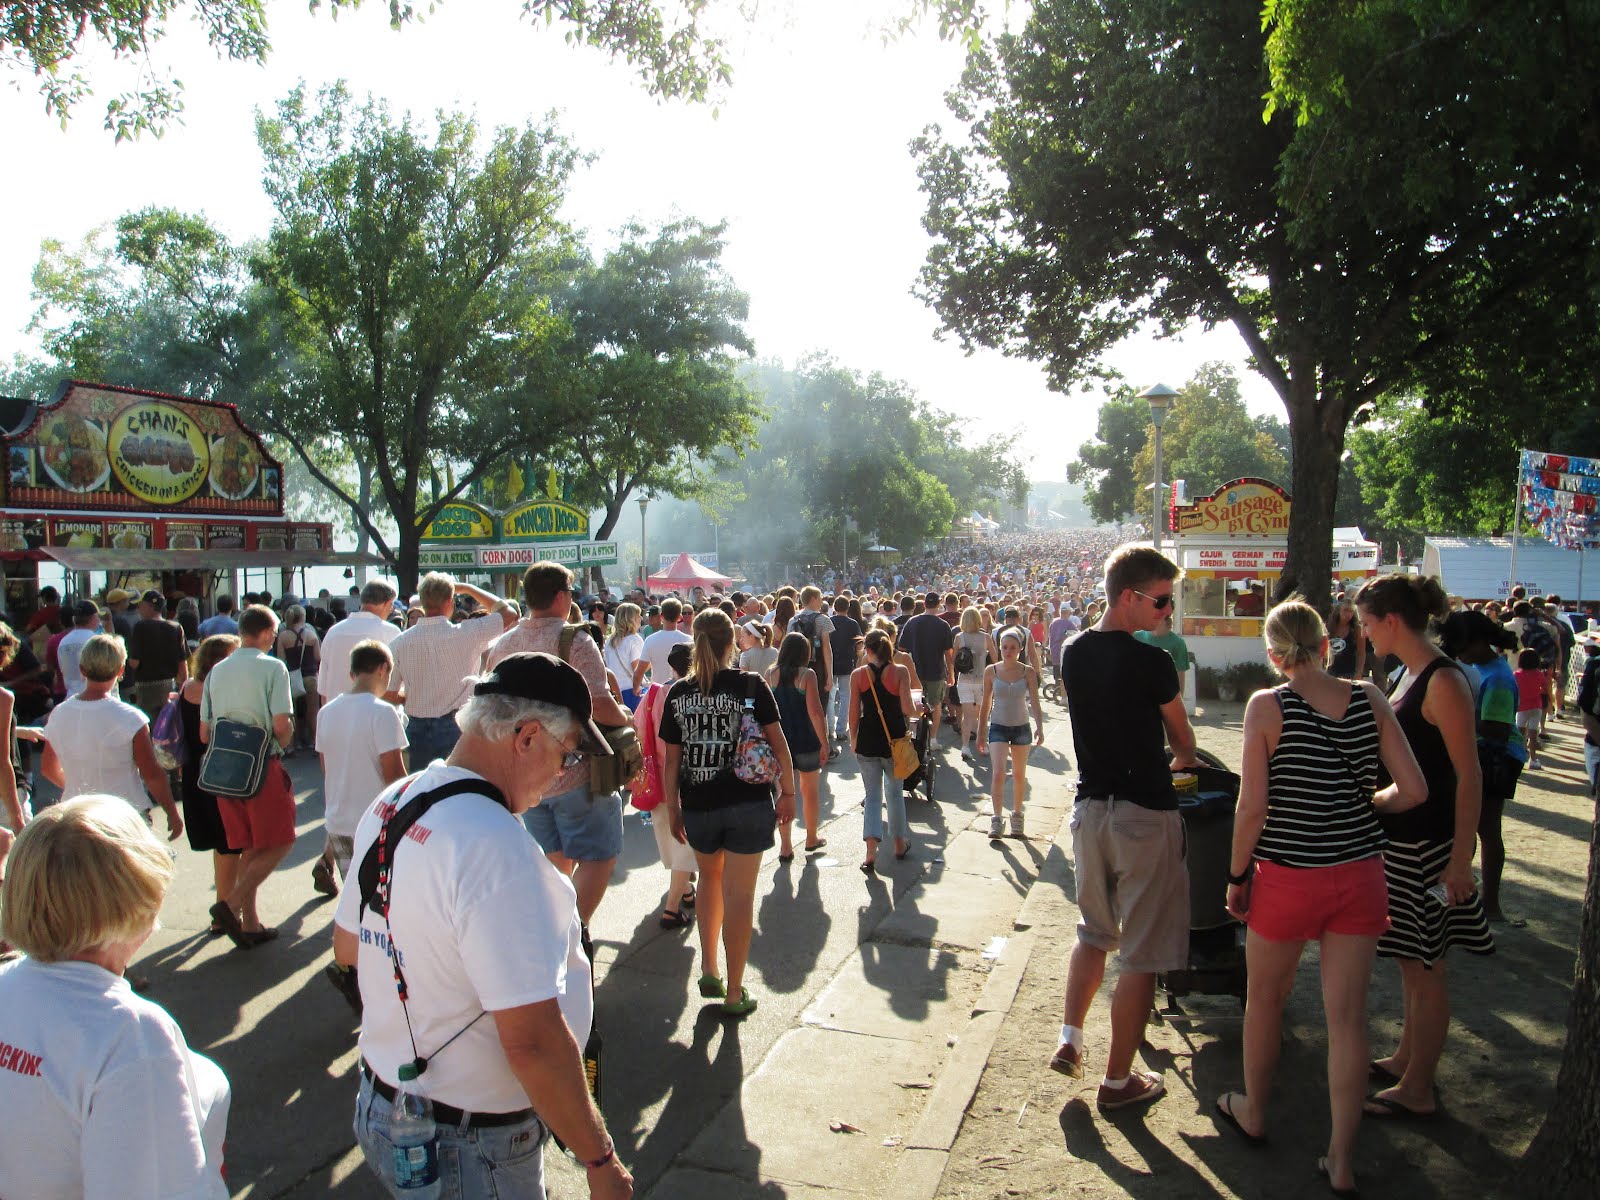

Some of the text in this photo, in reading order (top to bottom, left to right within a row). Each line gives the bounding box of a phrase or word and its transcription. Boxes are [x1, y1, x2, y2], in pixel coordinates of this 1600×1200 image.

[127, 411, 190, 439] CHAN'S
[115, 457, 205, 498] CHICKEN ON A STICK
[430, 507, 482, 524] NCHO
[514, 506, 579, 534] PONCHO DOGS
[1203, 496, 1284, 531] Sausage
[431, 522, 472, 536] DOGS
[1228, 511, 1289, 533] BY Cynt
[54, 522, 102, 537] LEMONADE
[107, 523, 126, 536] EGG
[126, 523, 151, 536] ROLLS
[418, 552, 474, 564] OG ON A STICK
[482, 550, 533, 564] CORN DOGS
[539, 548, 576, 562] HOT DOG
[581, 545, 615, 557] ON A STICK
[1199, 550, 1223, 559] CAJUN
[1231, 551, 1264, 559] GERMAN
[1272, 551, 1289, 559] ITAL
[1199, 559, 1227, 567] SWEDISH
[1234, 559, 1258, 568] CREOLE
[1265, 560, 1286, 568] MINNE
[683, 713, 731, 742] THE
